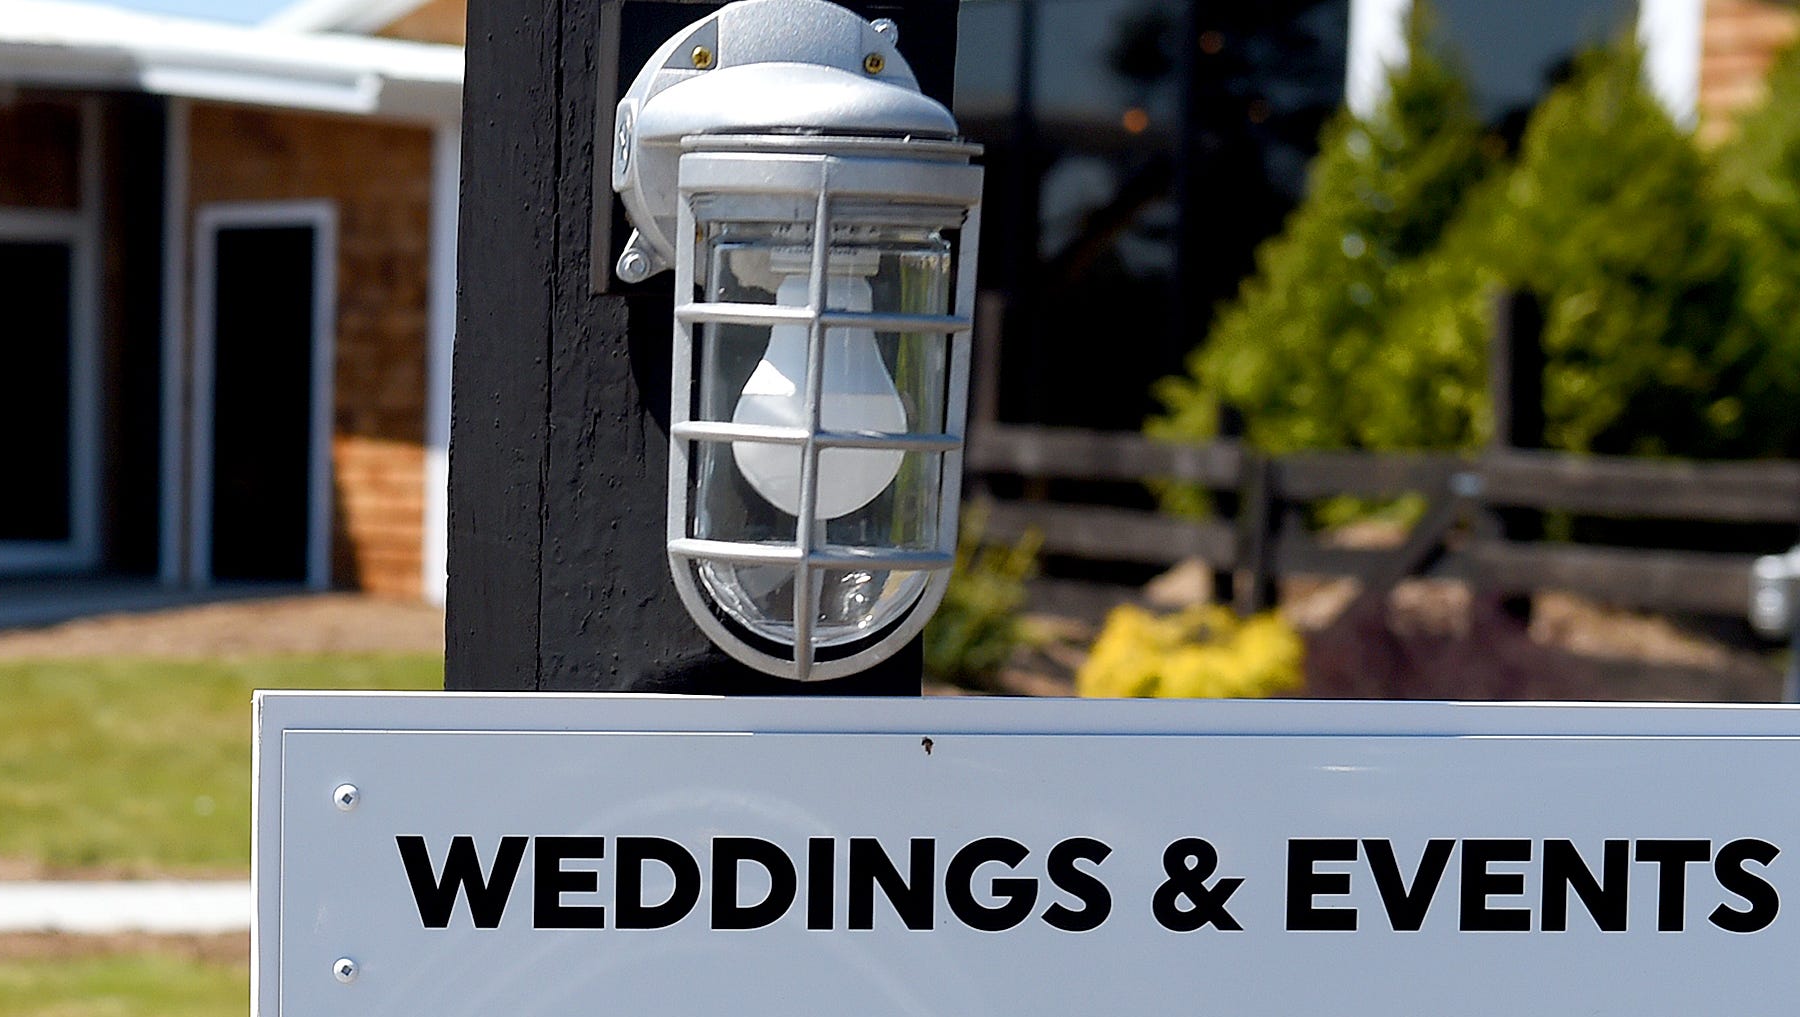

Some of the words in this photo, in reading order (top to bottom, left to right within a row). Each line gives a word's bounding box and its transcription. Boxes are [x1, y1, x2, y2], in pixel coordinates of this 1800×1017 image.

[395, 835, 1113, 932] WEDDINGS
[1152, 837, 1246, 933] &
[1285, 838, 1781, 933] EVENTS
